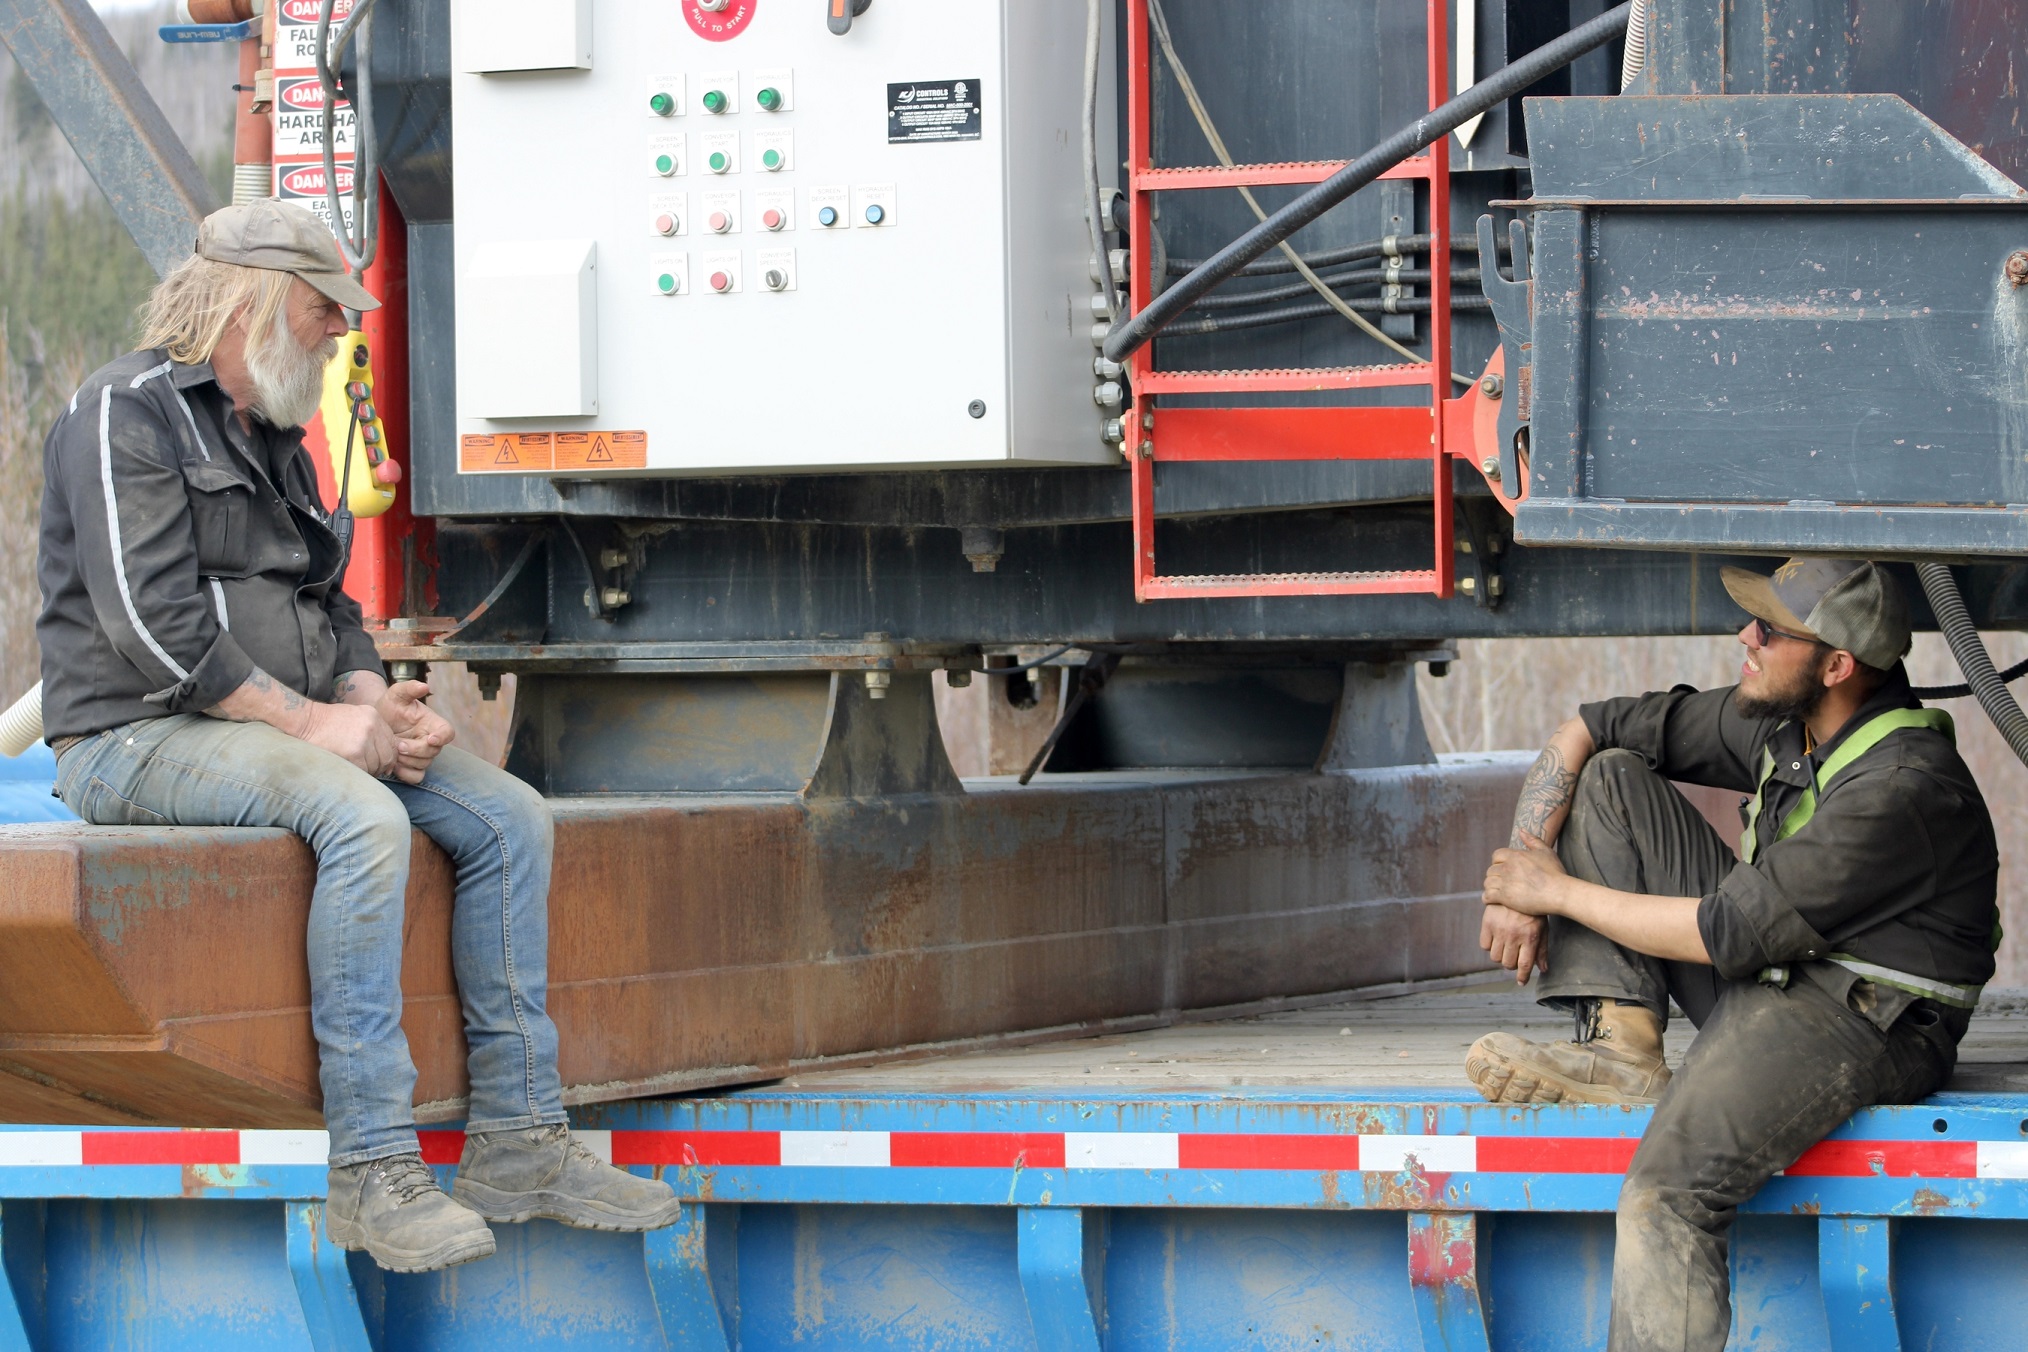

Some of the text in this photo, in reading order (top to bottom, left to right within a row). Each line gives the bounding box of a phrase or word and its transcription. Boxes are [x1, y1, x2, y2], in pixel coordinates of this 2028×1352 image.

[292, 0, 354, 16] DANER
[692, 8, 706, 28] PULL
[726, 5, 746, 29] START
[916, 89, 949, 97] CONTROLS
[333, 113, 356, 127] HA
[300, 130, 347, 144] ARA
[292, 172, 354, 189] DANER
[312, 201, 328, 210] EA
